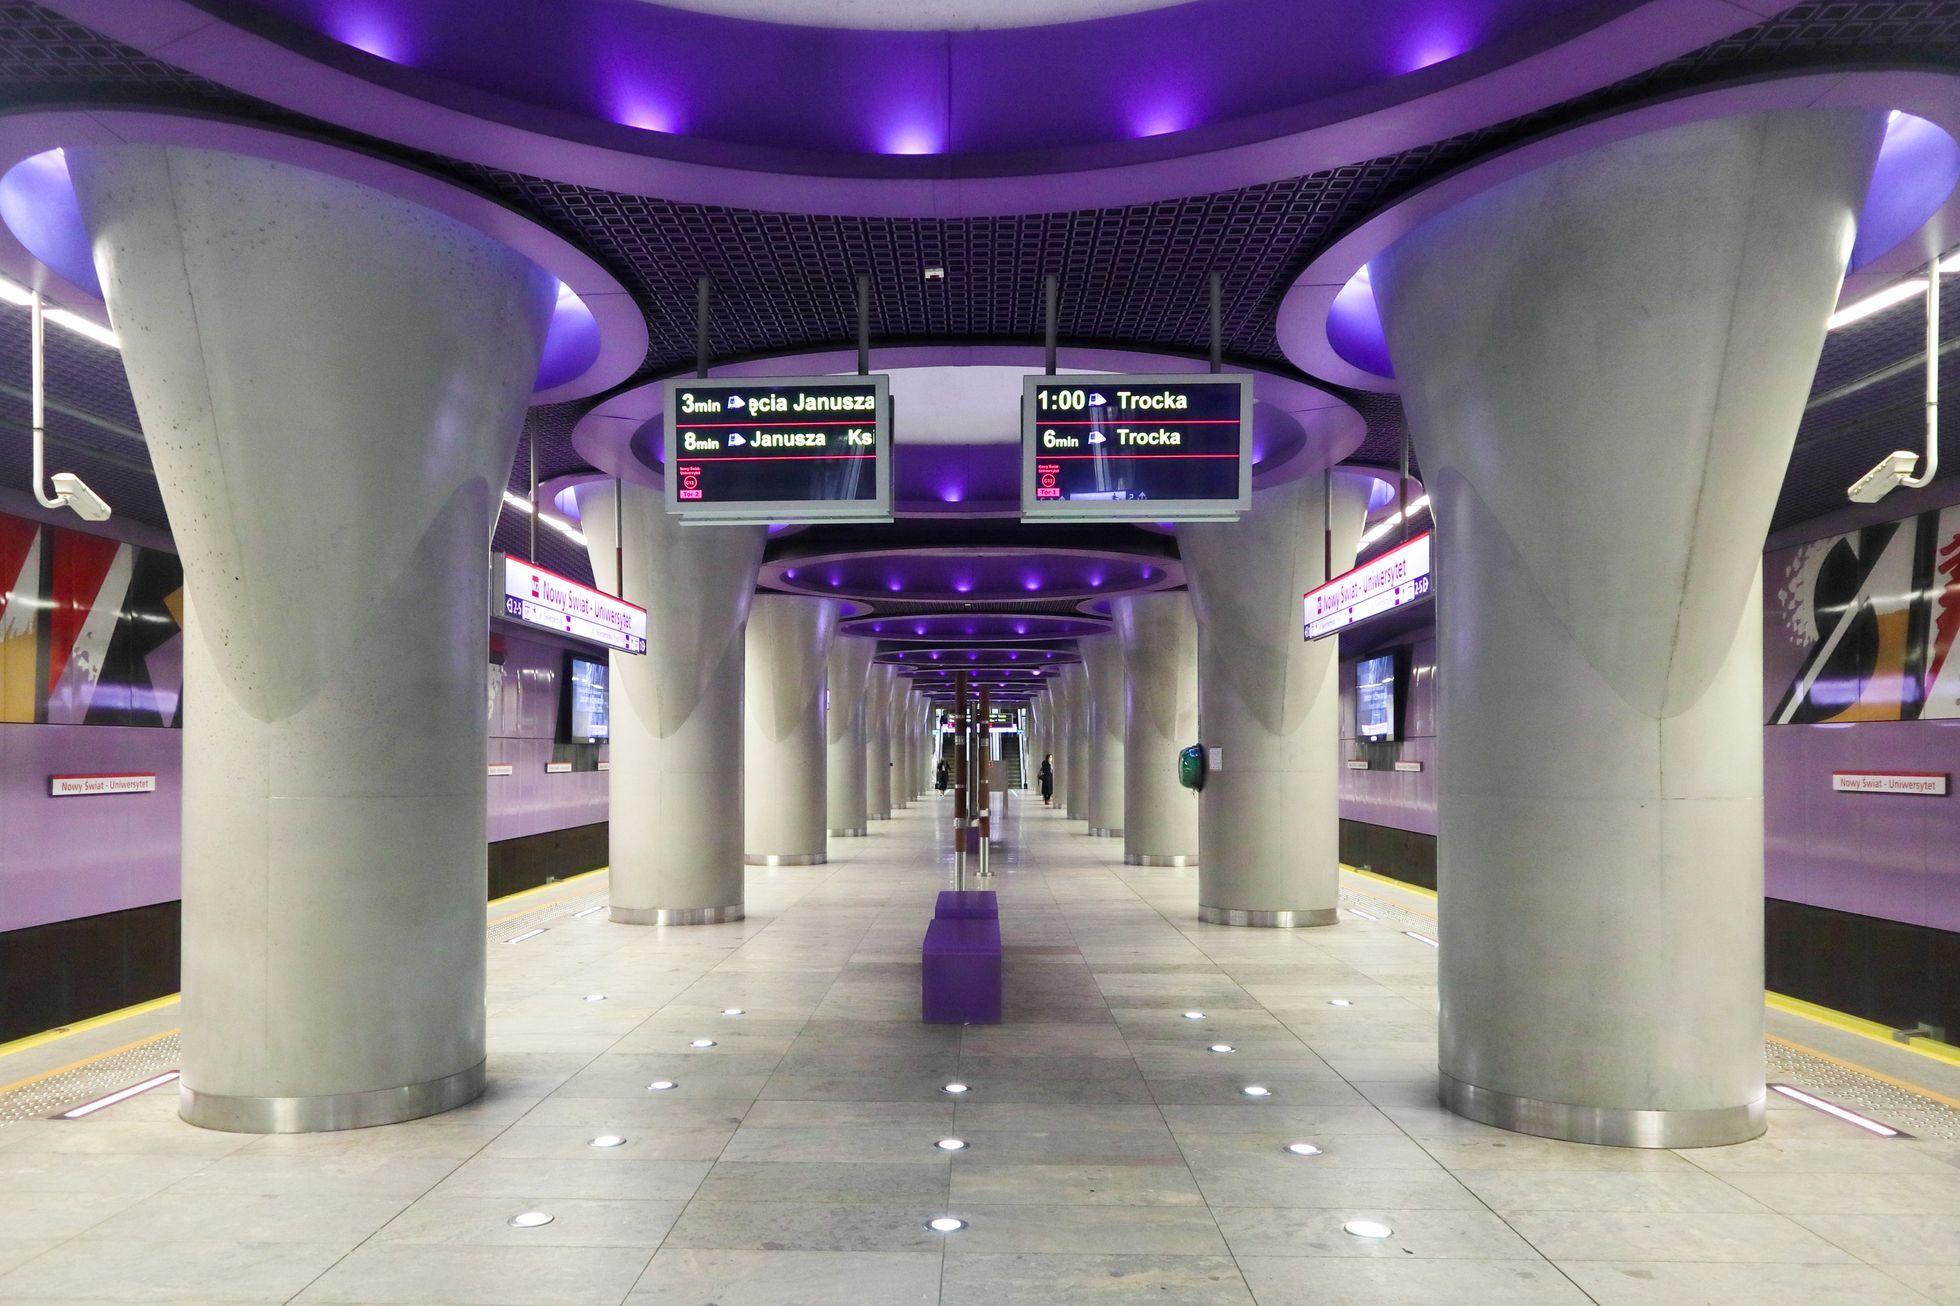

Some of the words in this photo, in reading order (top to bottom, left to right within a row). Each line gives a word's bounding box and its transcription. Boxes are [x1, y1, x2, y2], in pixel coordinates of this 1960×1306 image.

[682, 393, 721, 414] 3min
[749, 394, 787, 416] ęcia
[793, 393, 875, 411] Janusza
[1038, 390, 1085, 410] 1:00
[1117, 391, 1188, 410] Trocka
[684, 432, 720, 451] 8min
[750, 430, 826, 448] Janusza
[1043, 429, 1079, 449] 6min
[1117, 428, 1181, 446] Trocka
[1323, 594, 1340, 611] Nowy
[1363, 559, 1406, 593] Uniwersytet
[543, 580, 567, 611] Nowy
[594, 600, 631, 631] Uniwersytet
[61, 781, 83, 792] Nowy
[109, 780, 148, 790] Uniwersytet
[1840, 779, 1860, 791] Nowy
[1889, 779, 1936, 792] Uniwersytet
